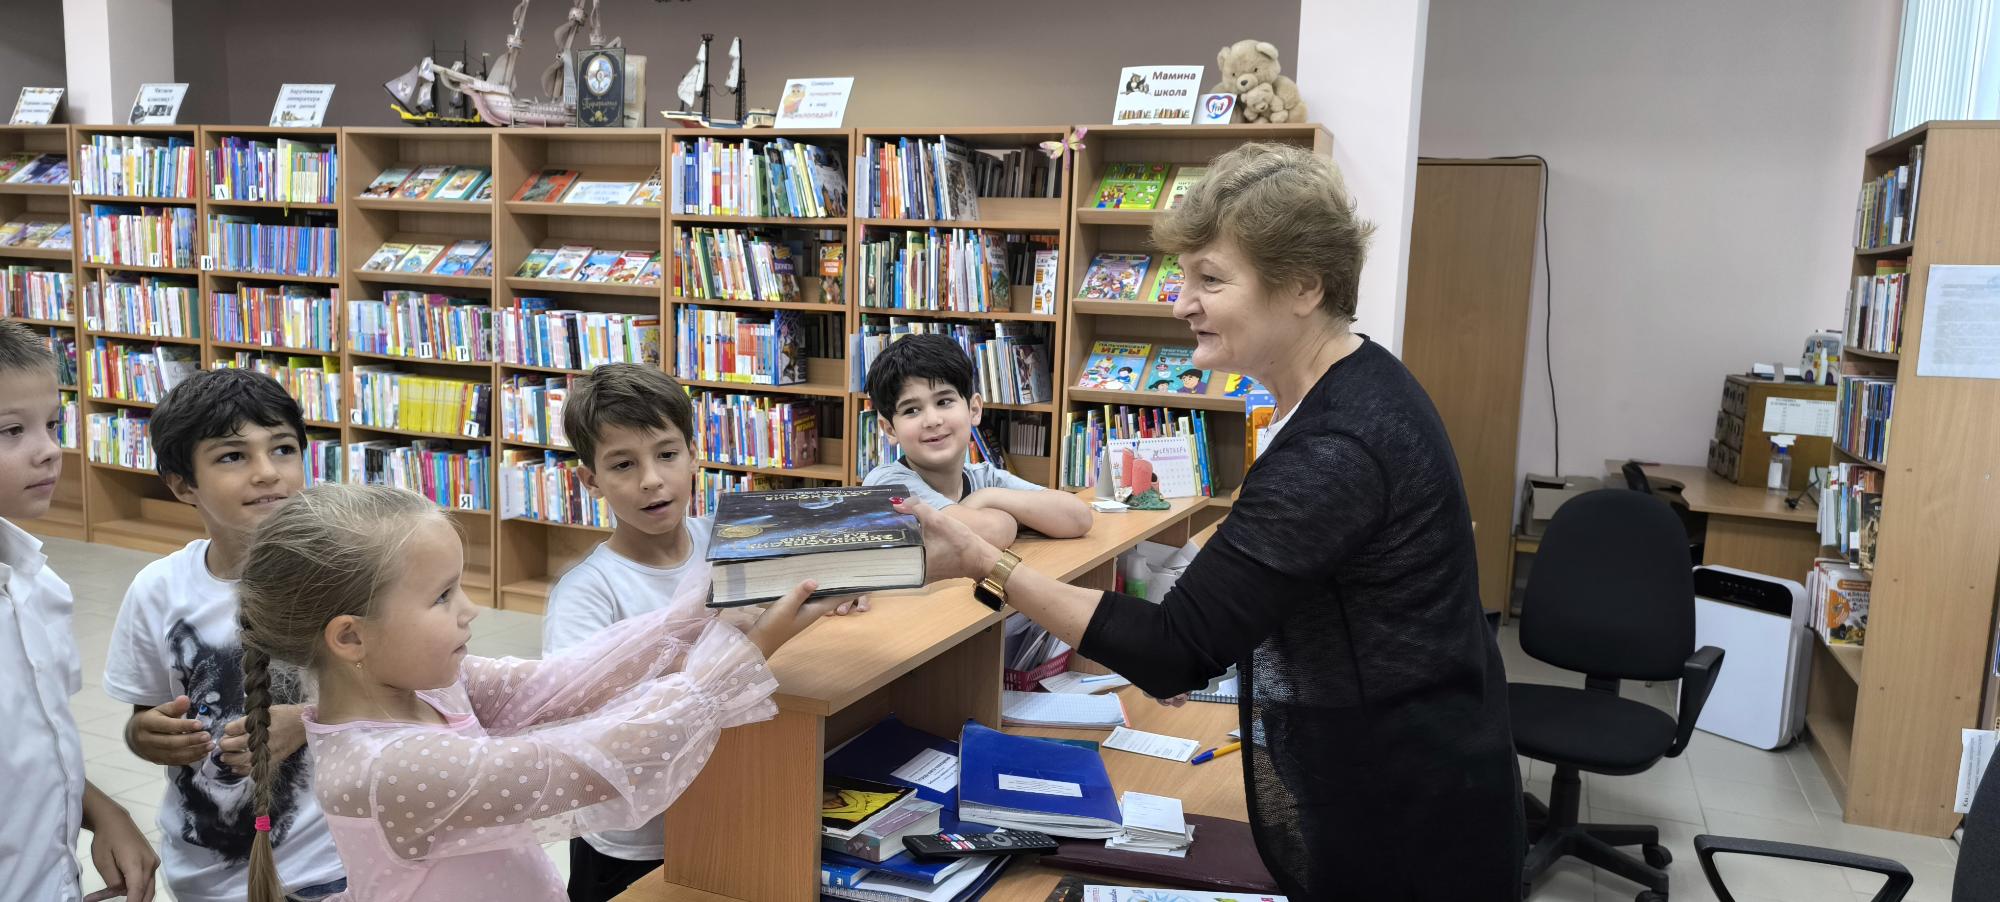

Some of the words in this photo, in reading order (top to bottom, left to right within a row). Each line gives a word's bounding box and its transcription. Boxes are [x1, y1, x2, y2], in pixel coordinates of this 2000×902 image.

[1152, 71, 1196, 81] Мамина
[1153, 87, 1188, 97] школа
[204, 257, 212, 269] В
[421, 343, 431, 356] П
[460, 347, 468, 359] Р
[1100, 346, 1141, 355] ИГРЫ
[350, 410, 361, 423] С
[464, 422, 477, 436] Т
[460, 495, 471, 509] Я
[764, 490, 872, 502] АСТРОНОМИЯ
